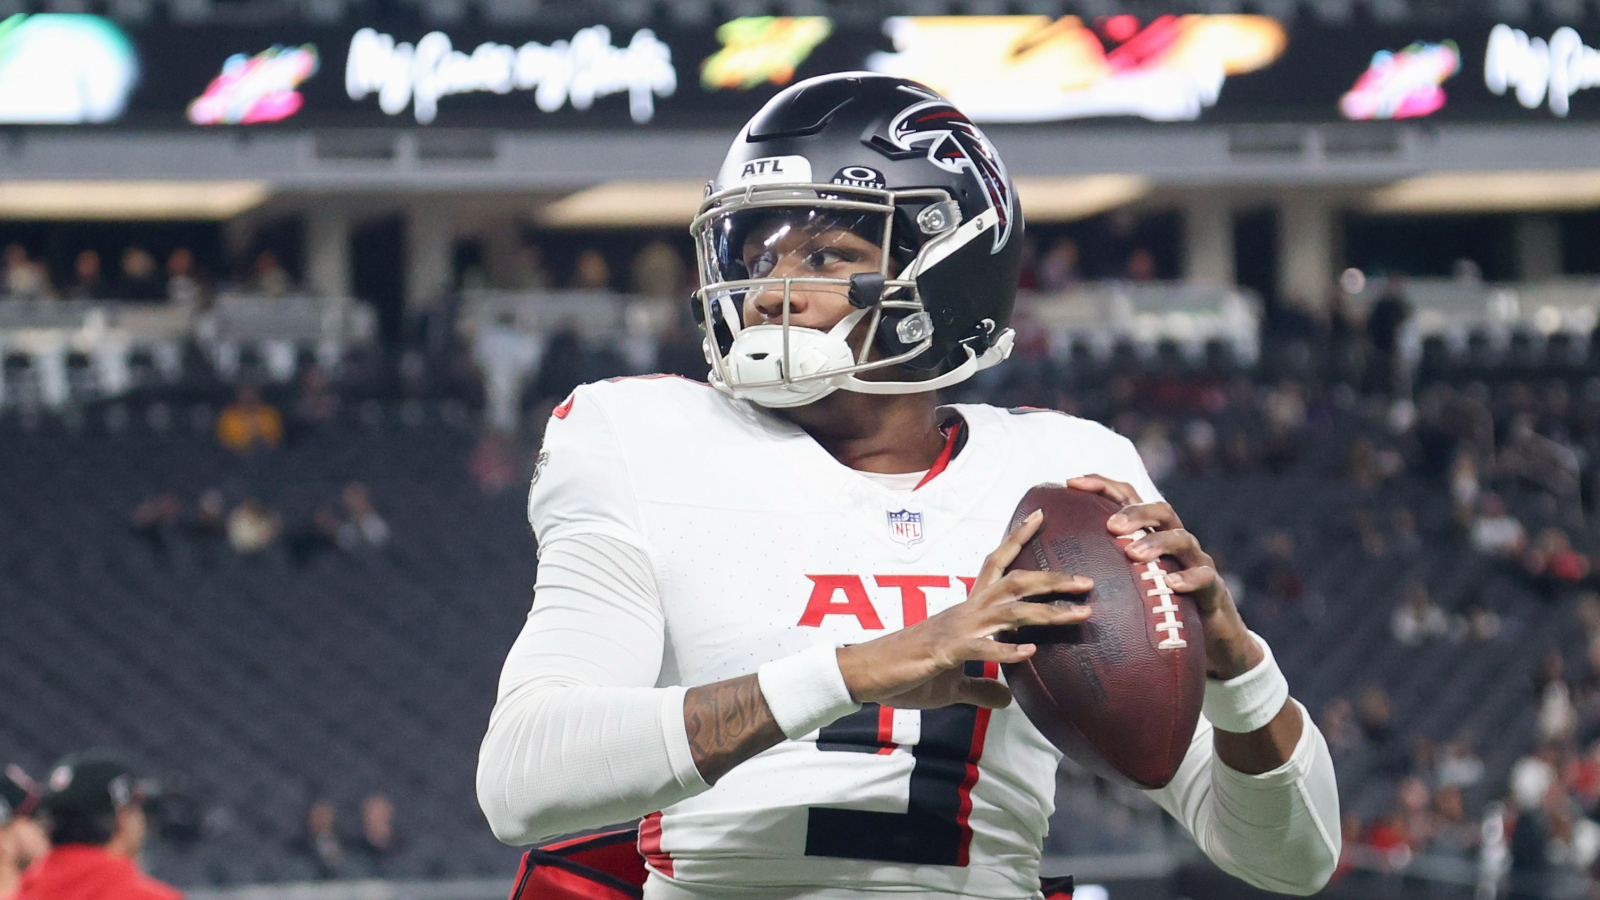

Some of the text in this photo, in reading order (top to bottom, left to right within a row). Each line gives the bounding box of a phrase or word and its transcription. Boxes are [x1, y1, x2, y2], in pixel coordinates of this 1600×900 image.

[741, 160, 783, 177] ATL
[833, 178, 884, 189] OAKLEY
[895, 522, 920, 538] NFL
[797, 574, 976, 630] AT
